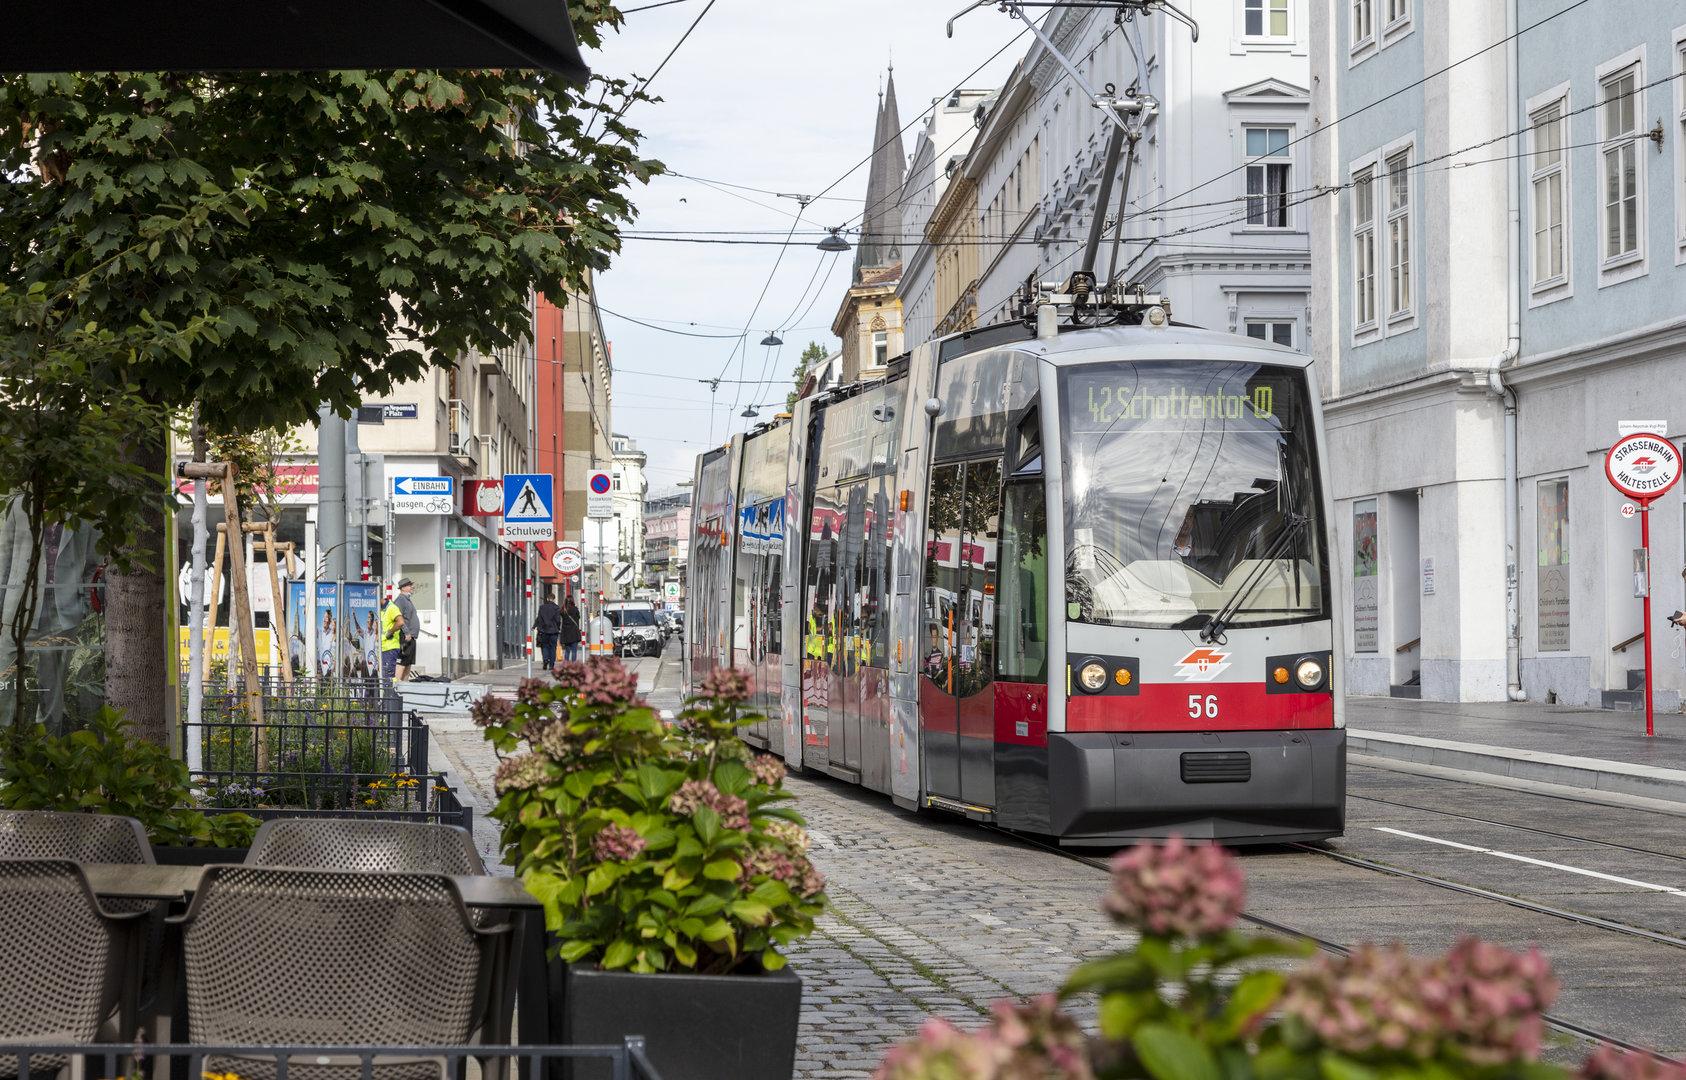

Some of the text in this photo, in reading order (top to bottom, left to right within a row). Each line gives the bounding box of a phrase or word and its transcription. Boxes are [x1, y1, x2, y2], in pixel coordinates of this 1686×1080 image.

[1088, 386, 1112, 422] 42
[1117, 386, 1250, 419] Schottentor
[1615, 440, 1674, 462] STRASSENBAHN
[412, 482, 446, 490] EINBAHN
[1617, 470, 1671, 490] HALTESTELLE
[396, 501, 426, 510] ausgen.
[1621, 506, 1634, 515] 42
[506, 526, 552, 537] Schulweg
[1188, 694, 1219, 719] 56
